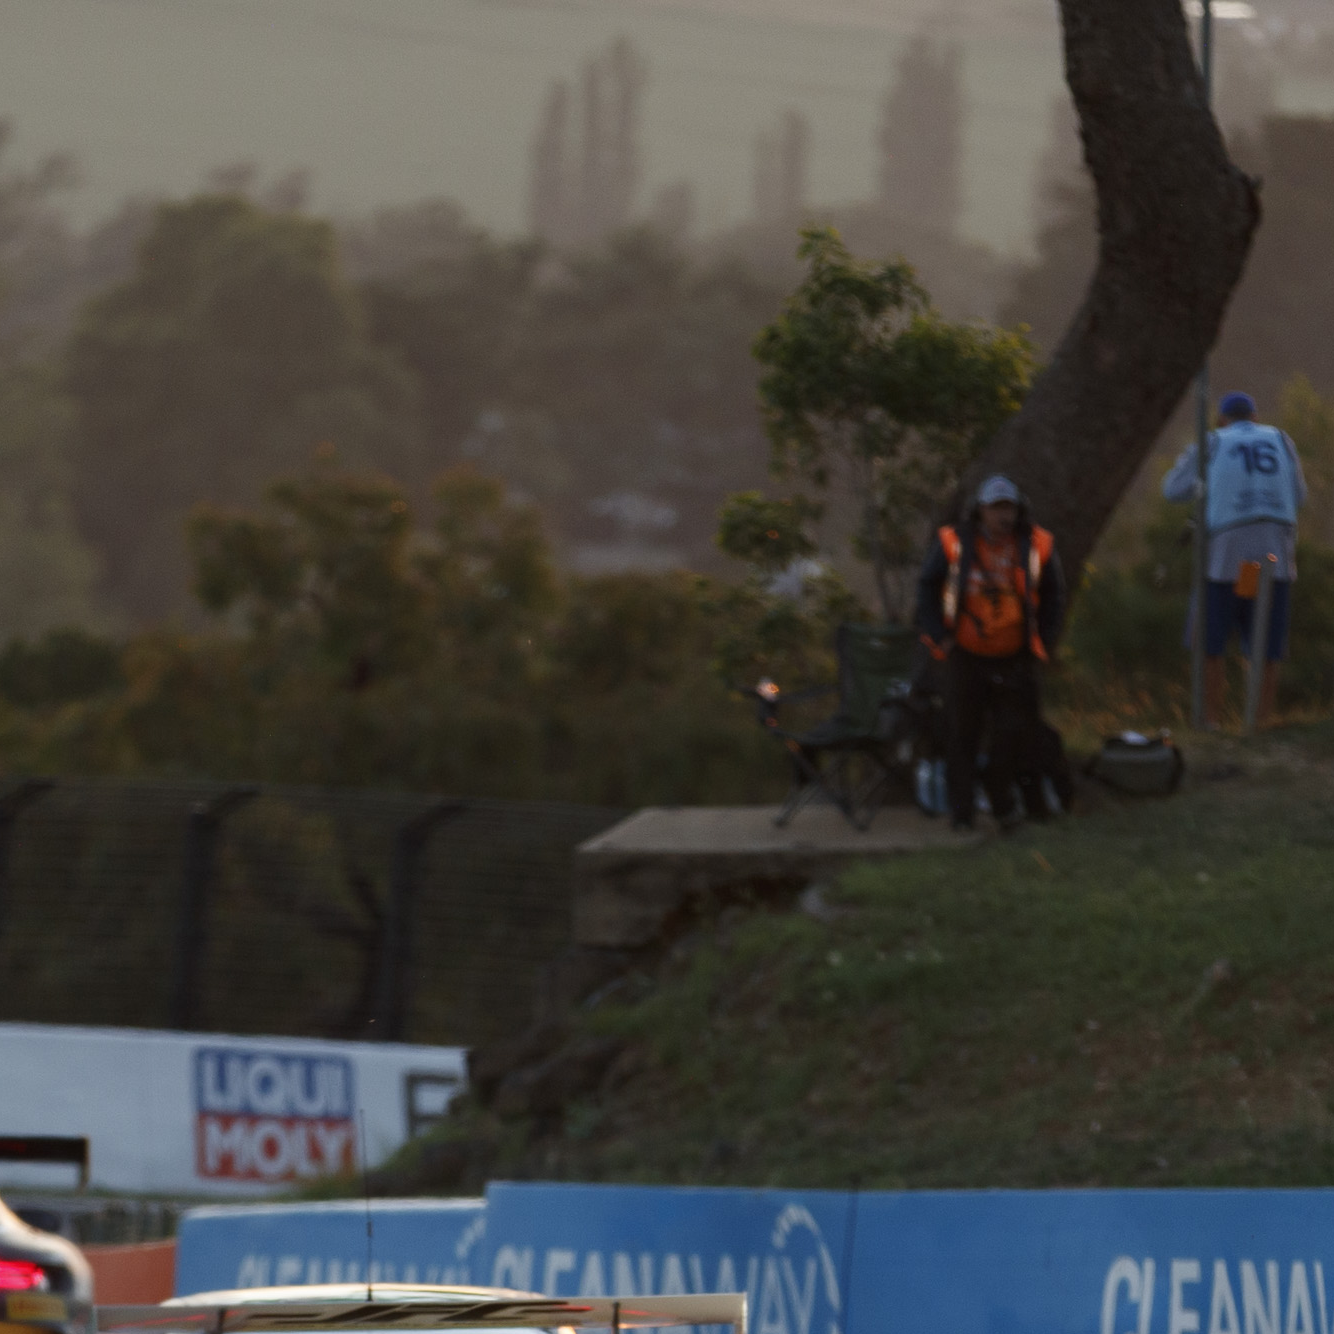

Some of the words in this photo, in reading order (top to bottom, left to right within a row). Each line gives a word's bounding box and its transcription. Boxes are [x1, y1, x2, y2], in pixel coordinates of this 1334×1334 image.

[1229, 441, 1280, 477] 16
[203, 1055, 349, 1112] LIQUI
[203, 1119, 352, 1176] MOLY
